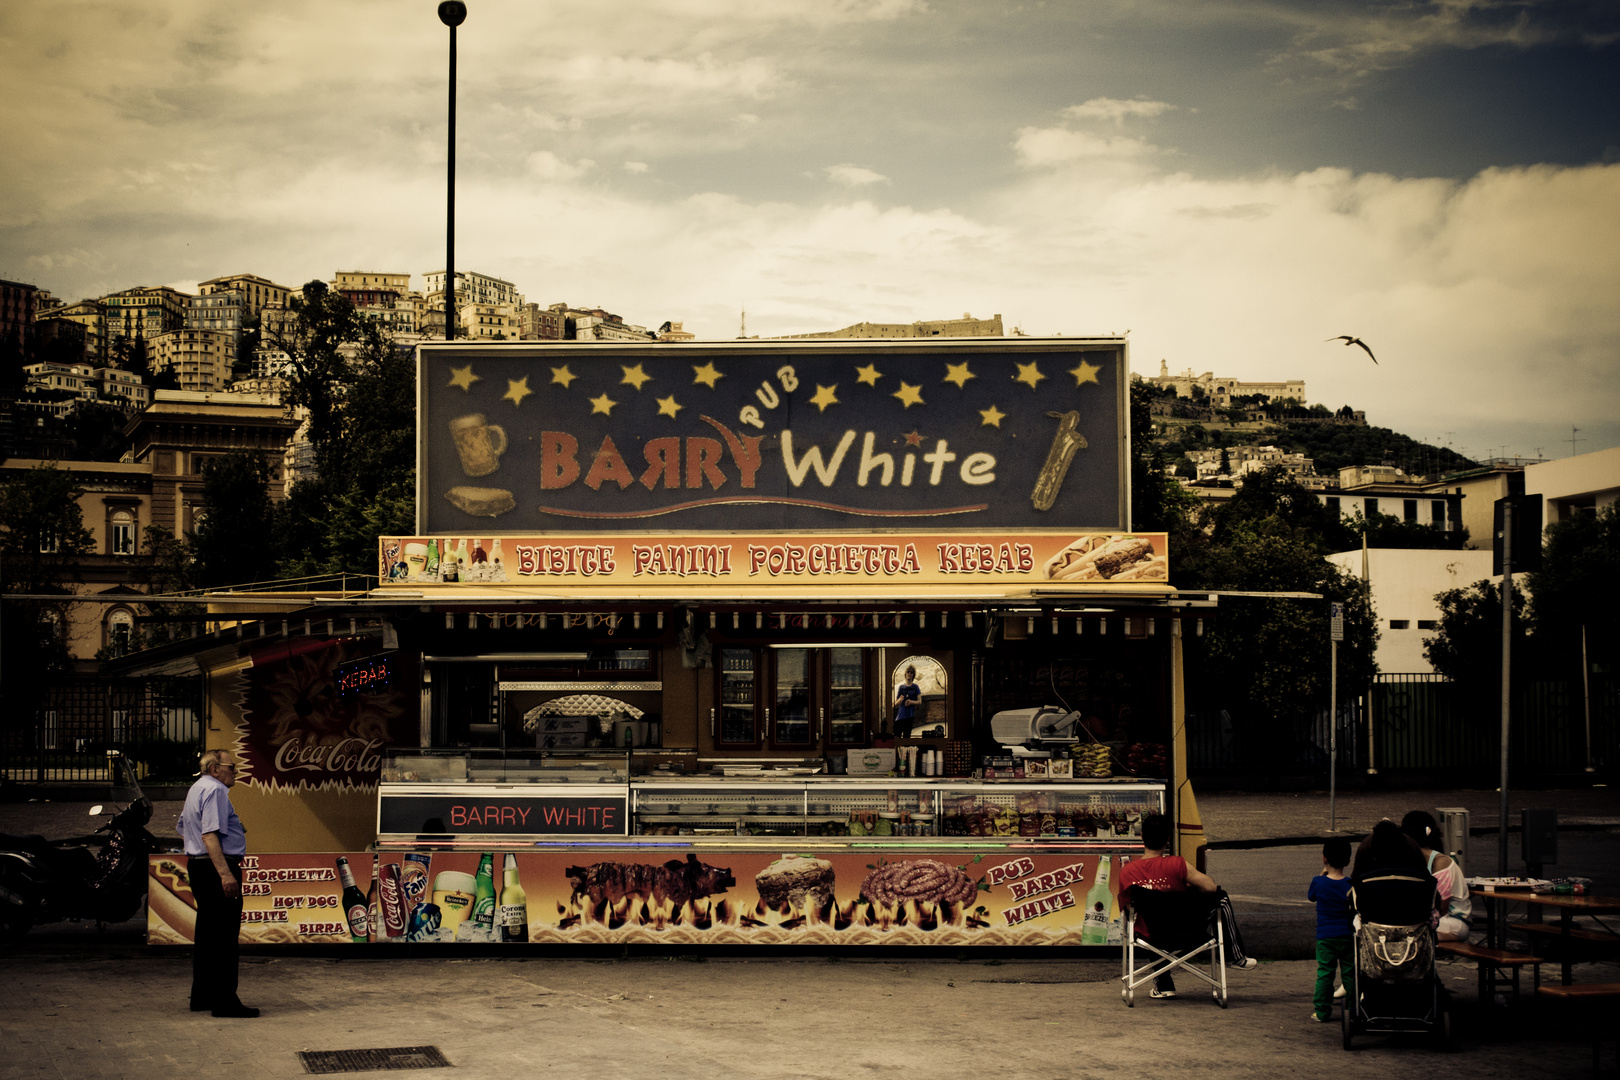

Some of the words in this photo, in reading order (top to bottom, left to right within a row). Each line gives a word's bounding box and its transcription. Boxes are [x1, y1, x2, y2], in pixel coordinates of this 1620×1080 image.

[739, 364, 799, 429] PUB
[540, 414, 765, 491] BARRY
[781, 429, 996, 487] White
[516, 544, 616, 576] BIBITE
[632, 544, 732, 576] PANINI
[748, 542, 921, 576] PORCHETTA
[938, 542, 1035, 573] KEBAB
[341, 664, 387, 691] KEBAB
[451, 806, 531, 826] BARRY
[543, 806, 616, 828] WHITE
[247, 868, 336, 883] PORCHETTA
[987, 857, 1035, 885] PUB
[1007, 863, 1084, 902] BARRY
[242, 883, 272, 896] BAB
[272, 896, 305, 909] HOT
[306, 895, 338, 908] DOG
[240, 909, 288, 923] BIBITE
[1001, 889, 1076, 926] WHITE
[297, 922, 346, 936] BIRRA
